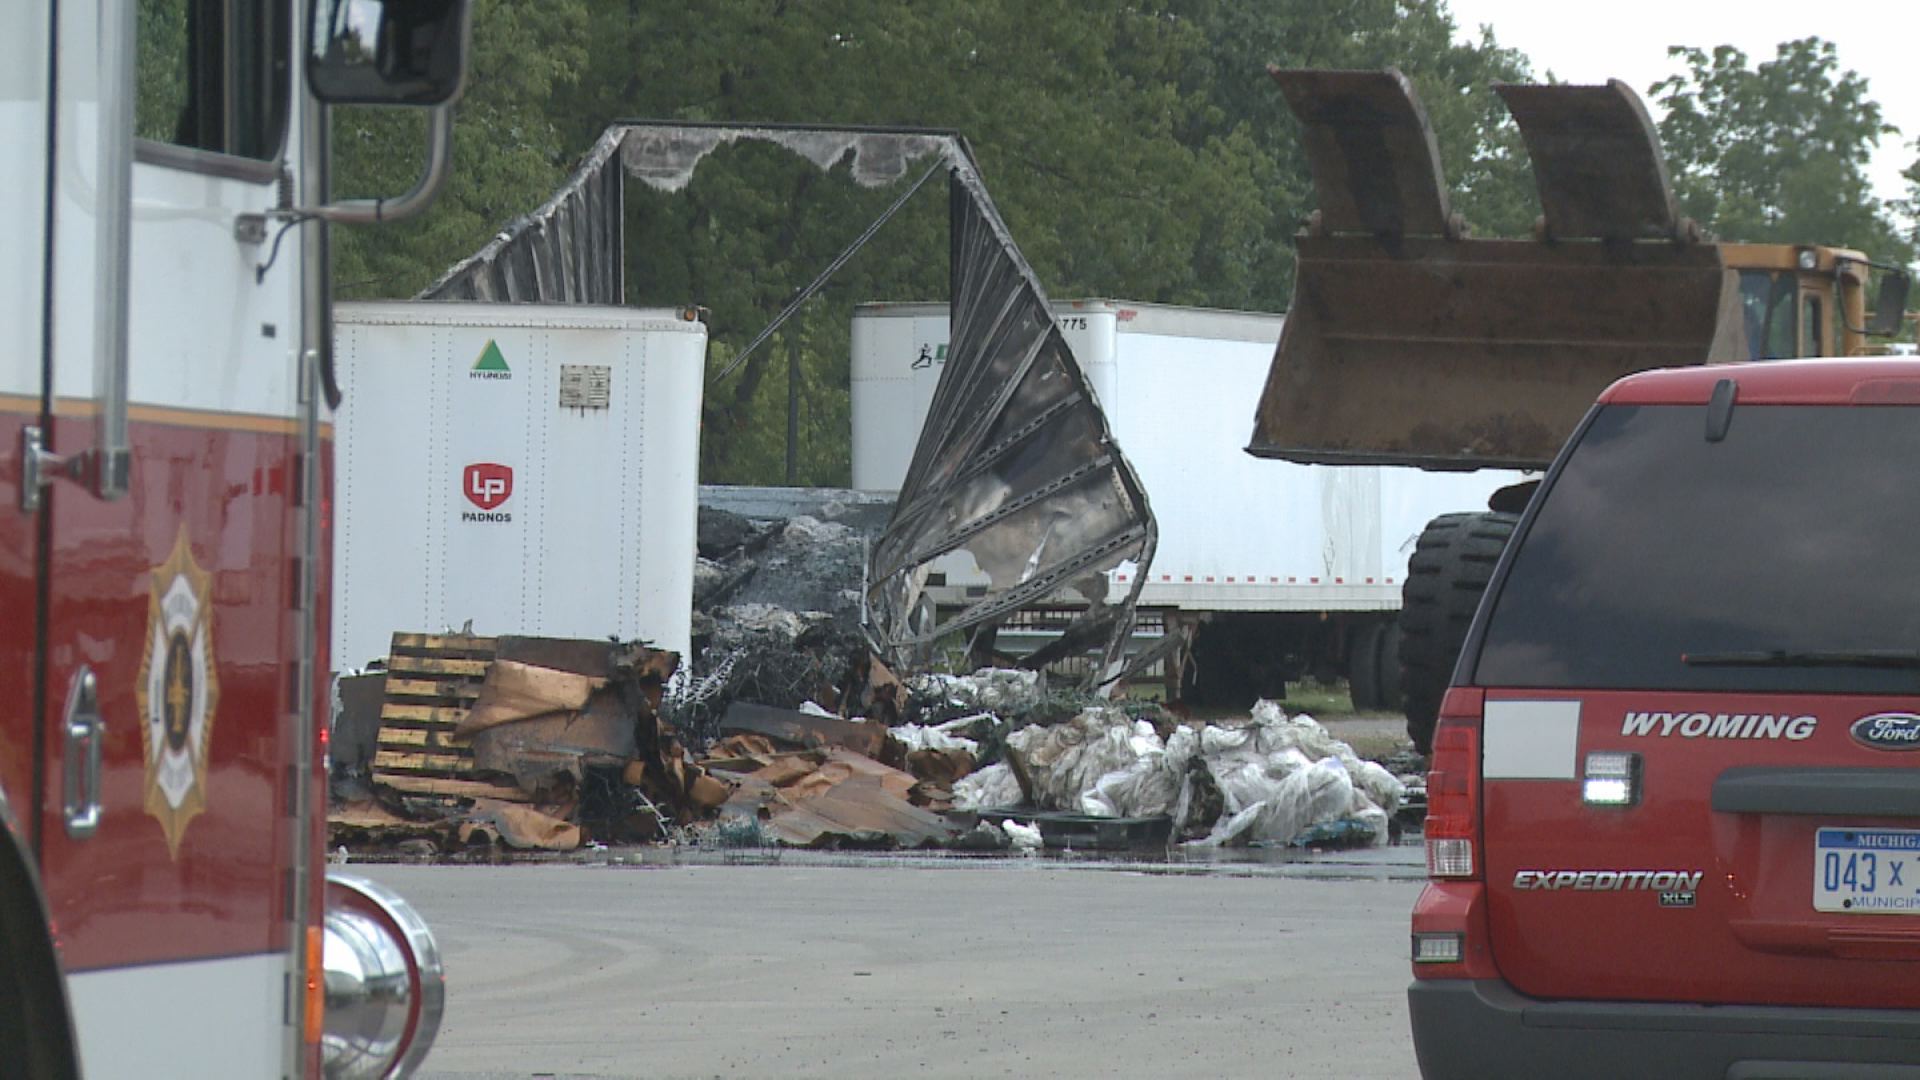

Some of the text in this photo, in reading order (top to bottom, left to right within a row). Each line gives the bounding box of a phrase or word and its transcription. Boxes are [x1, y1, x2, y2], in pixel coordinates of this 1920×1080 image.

[1062, 317, 1087, 330] 775
[472, 470, 505, 502] LP
[462, 512, 512, 522] PADNOS
[1621, 712, 1817, 740] WYOMING
[1868, 718, 1920, 740] Ford
[1513, 871, 1703, 891] EXPEDITION
[1825, 852, 1876, 892] 043
[1662, 893, 1693, 904] XLT
